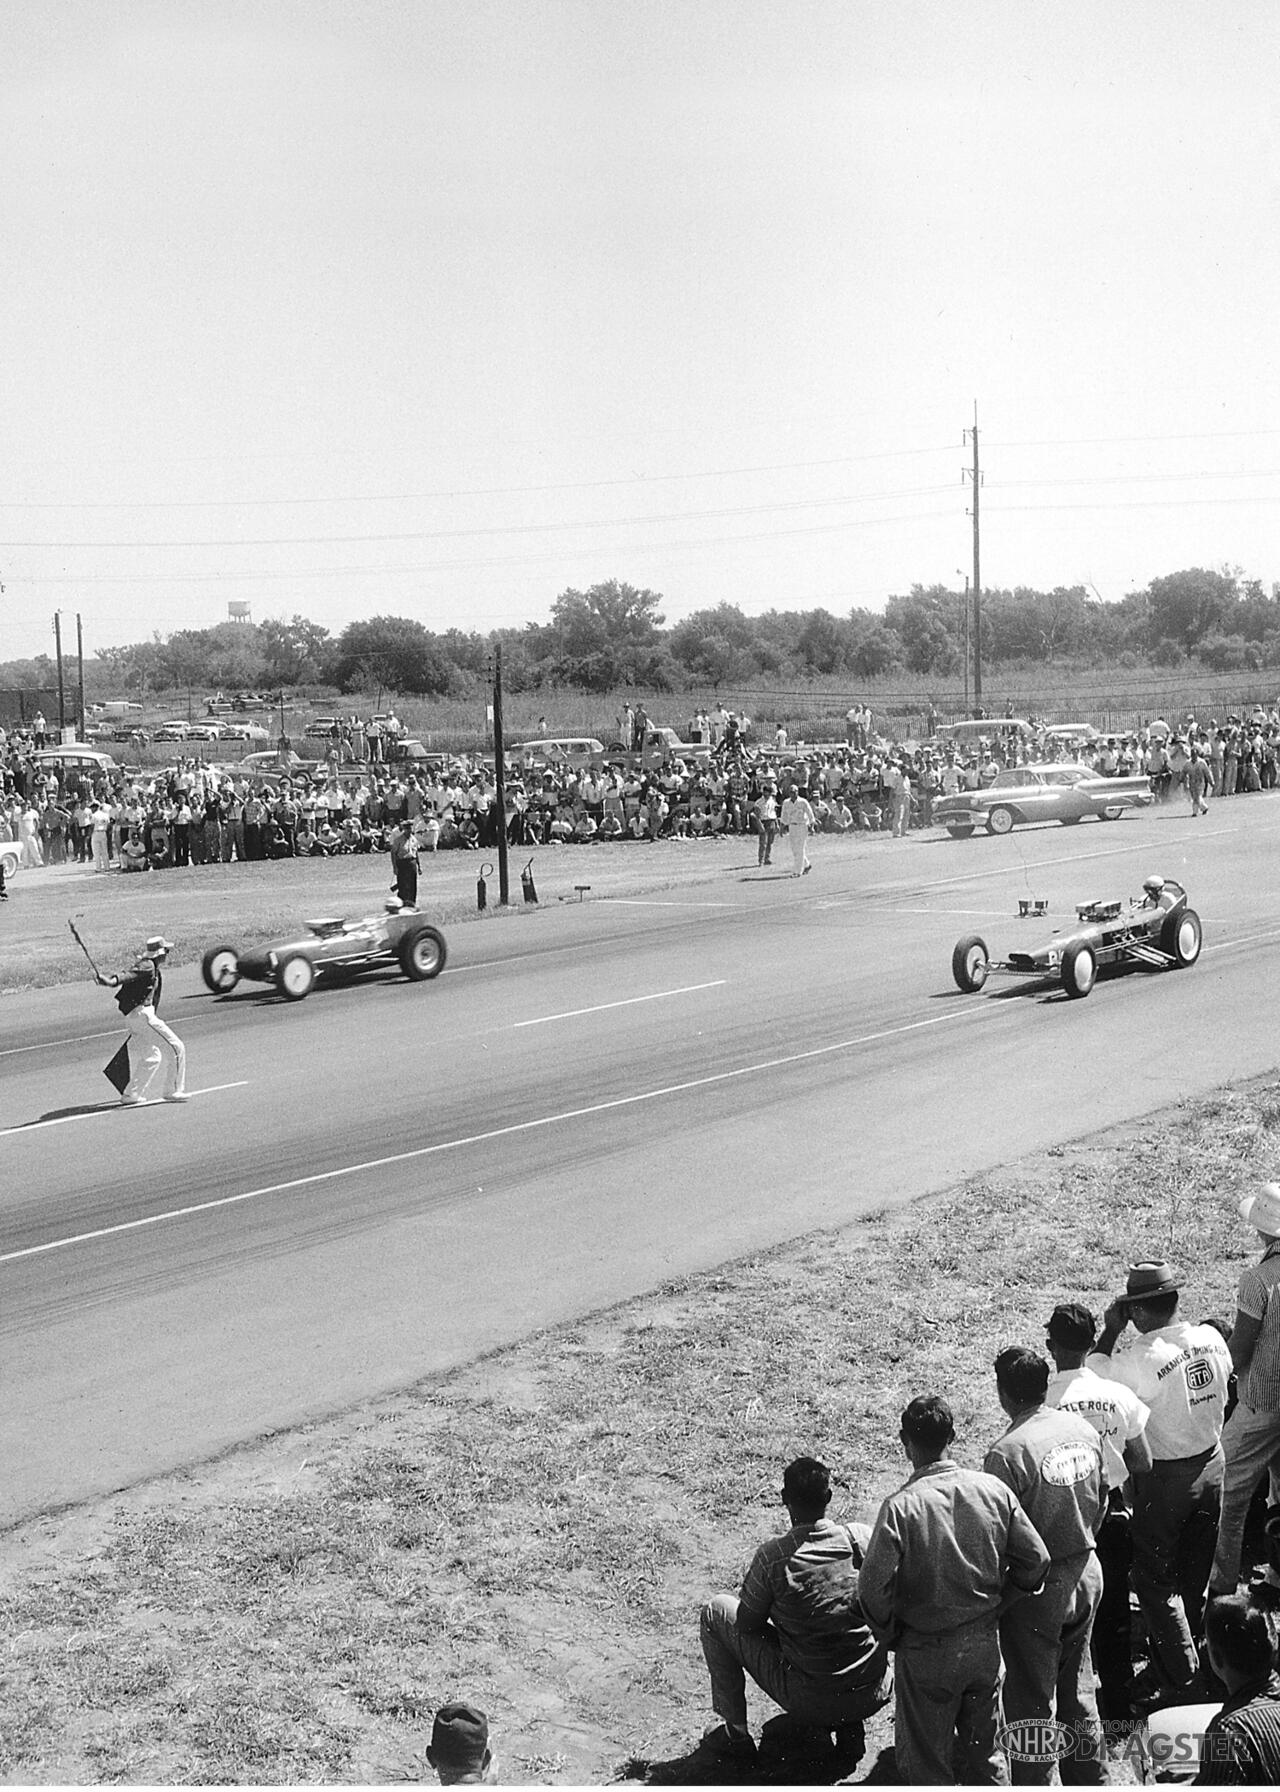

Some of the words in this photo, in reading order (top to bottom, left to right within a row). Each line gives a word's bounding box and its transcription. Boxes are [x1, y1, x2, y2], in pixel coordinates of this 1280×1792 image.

[1156, 1350, 1190, 1381] ARKANSAS
[1190, 1369, 1210, 1387] ATA
[1088, 1400, 1116, 1413] ROCK
